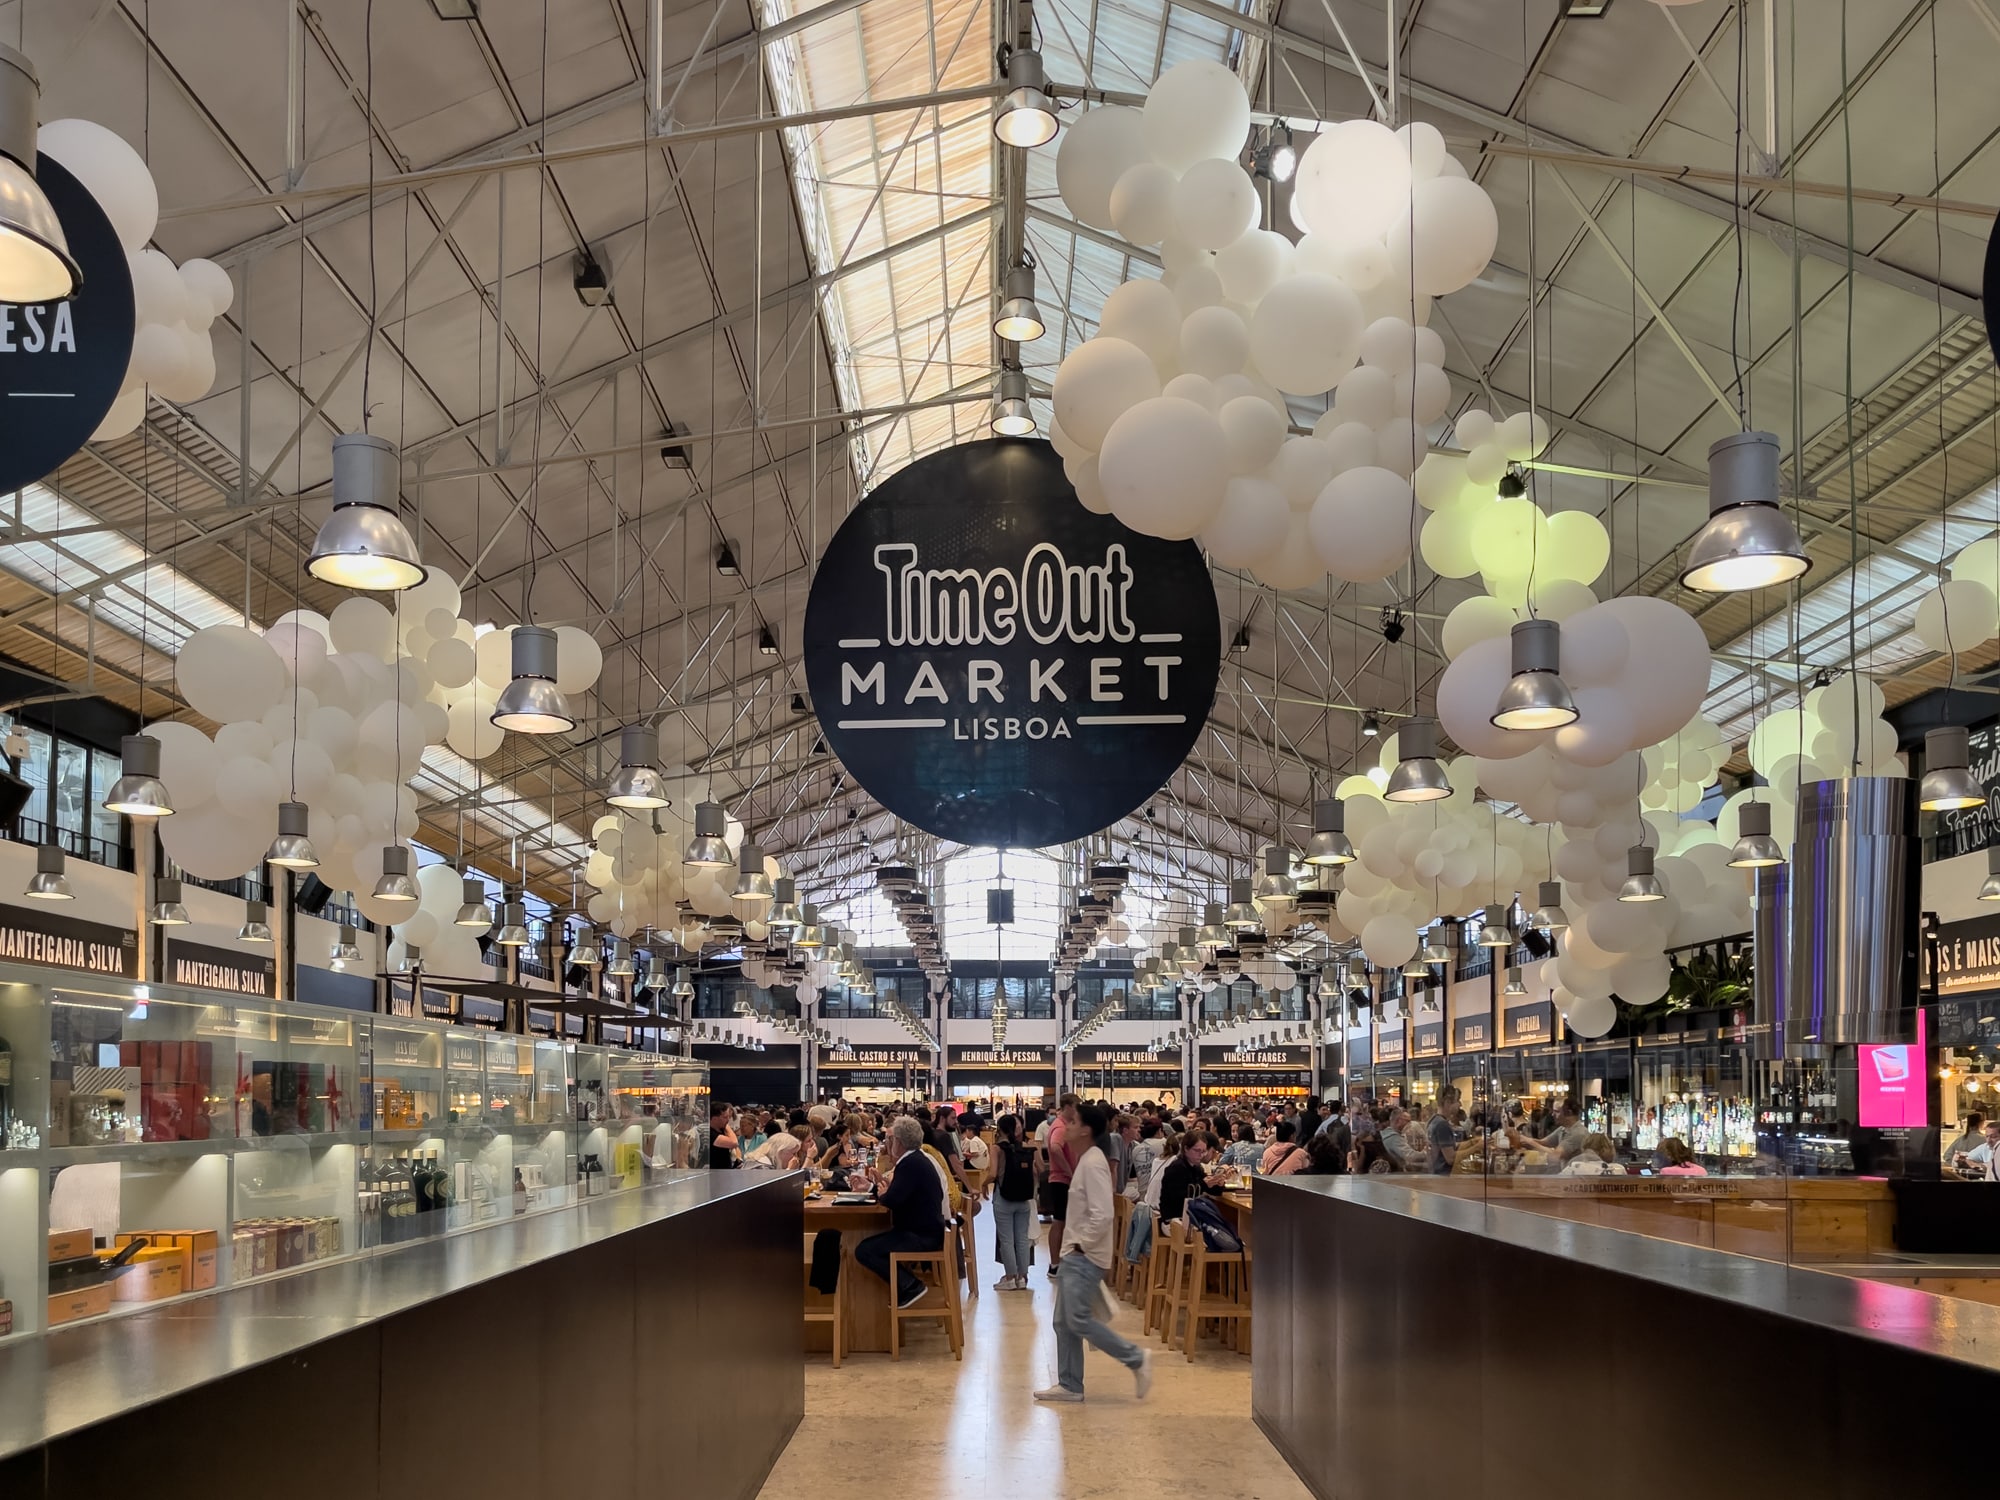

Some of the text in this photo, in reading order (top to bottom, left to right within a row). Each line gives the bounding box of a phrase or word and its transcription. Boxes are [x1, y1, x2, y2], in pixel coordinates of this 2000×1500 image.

[841, 656, 1183, 706] MARKET
[953, 716, 1073, 741] LISBOA
[89, 943, 123, 973] SILVA
[1954, 937, 1962, 971] É
[1966, 936, 2000, 969] MAIS
[176, 958, 240, 992] MANTEIGARIA
[241, 970, 266, 995] SILVA
[829, 1051, 858, 1062] MIGUEL
[860, 1051, 888, 1062] CASTRO
[890, 1051, 895, 1062] E
[961, 1049, 1042, 1062] HENRIQUE SÁ PESSOA
[1132, 1051, 1159, 1063] VIEIRA
[1223, 1051, 1288, 1063] VINCENT FARGES
